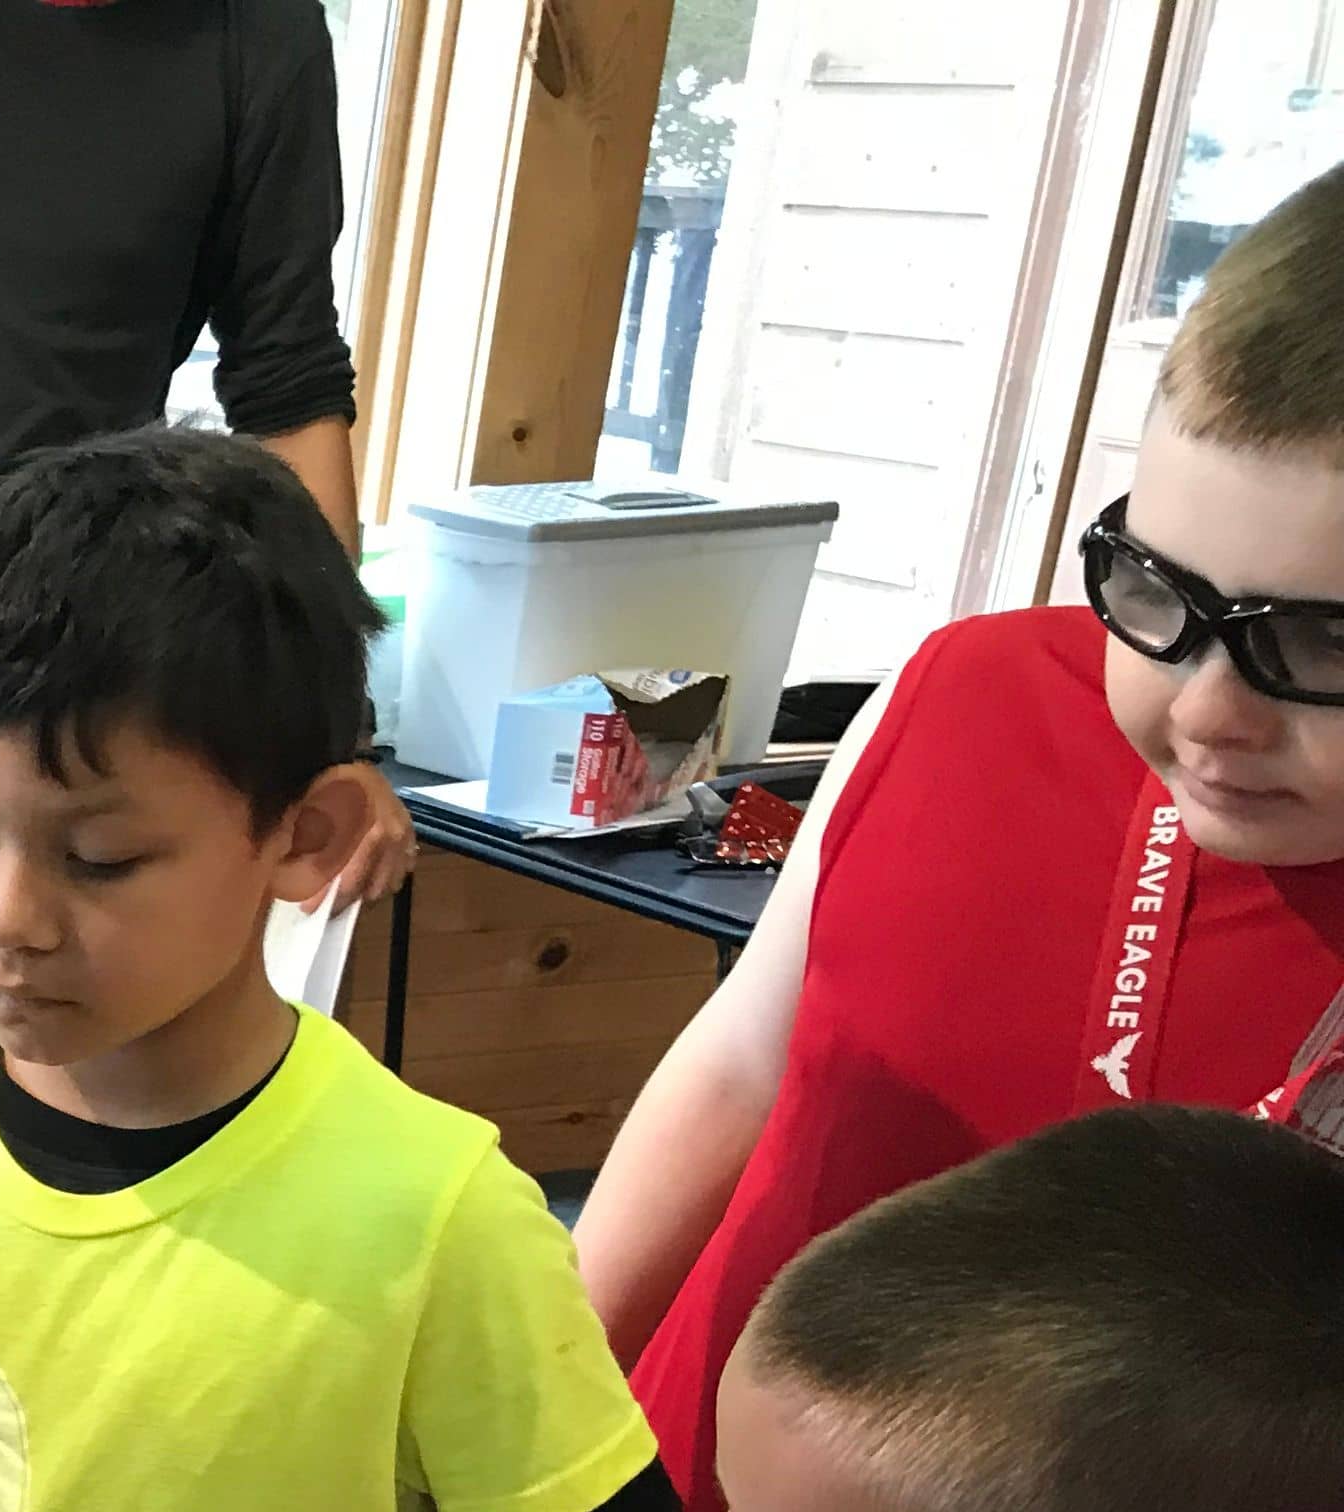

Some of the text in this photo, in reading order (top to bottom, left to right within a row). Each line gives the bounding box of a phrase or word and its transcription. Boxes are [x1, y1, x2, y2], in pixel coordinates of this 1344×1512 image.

[590, 719, 606, 742] 110
[1107, 806, 1180, 1028] BRAVE EAGLE
